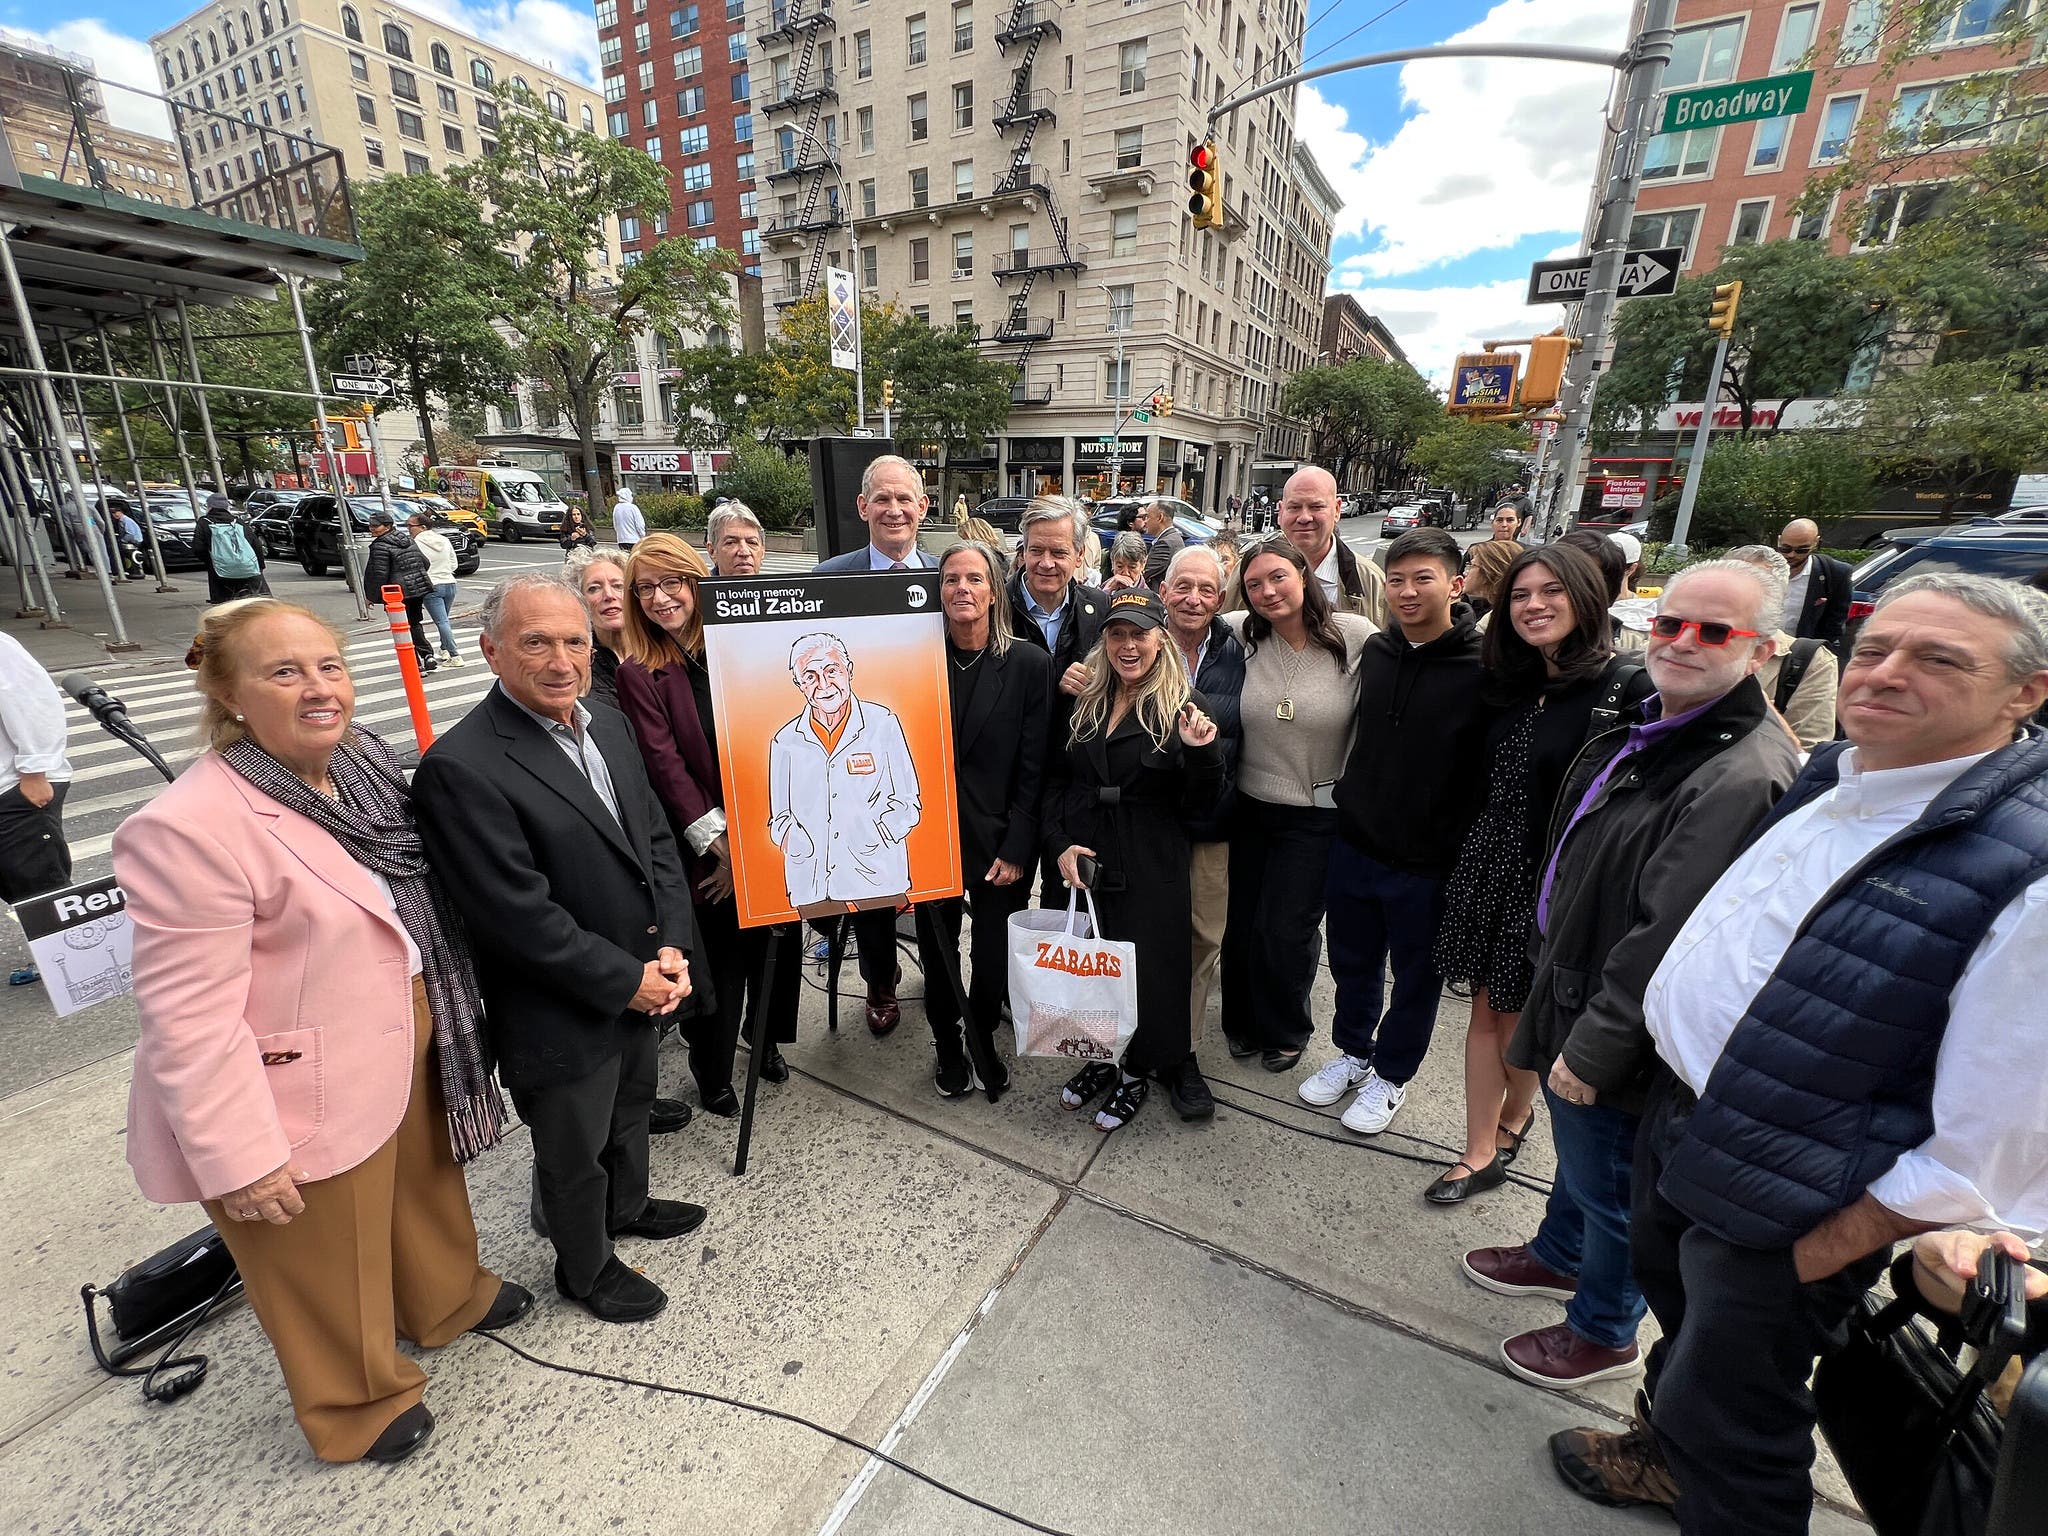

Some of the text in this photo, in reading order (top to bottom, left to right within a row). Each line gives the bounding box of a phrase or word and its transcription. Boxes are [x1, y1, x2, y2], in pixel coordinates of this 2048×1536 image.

[1675, 87, 1792, 125] Broadway
[834, 272, 847, 280] NYC
[1550, 270, 1591, 290] ONE
[342, 380, 384, 391] ONE WAY
[1081, 443, 1105, 453] NUTS
[629, 454, 680, 471] STAPLES
[1606, 479, 1623, 487] Fios
[715, 588, 805, 600] In loving memory
[716, 597, 824, 617] Saul Zabar
